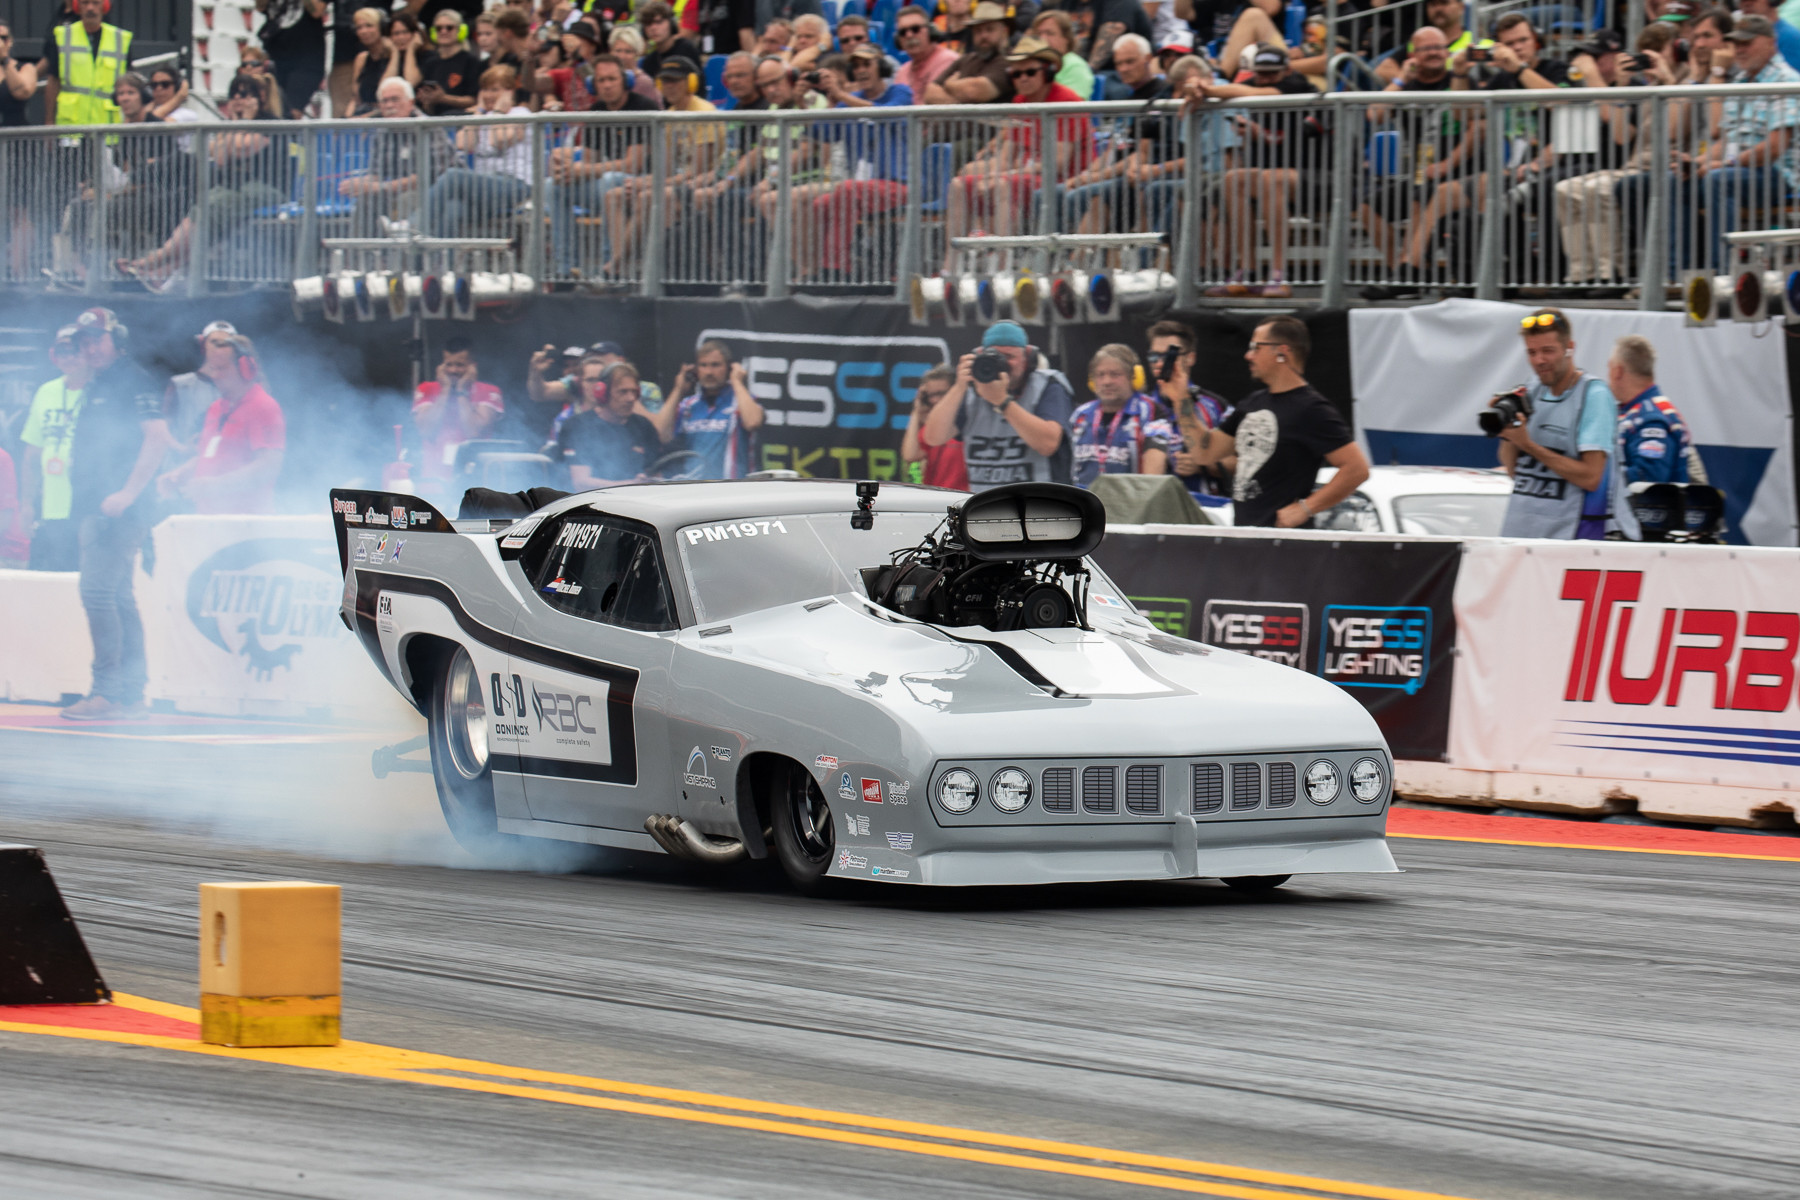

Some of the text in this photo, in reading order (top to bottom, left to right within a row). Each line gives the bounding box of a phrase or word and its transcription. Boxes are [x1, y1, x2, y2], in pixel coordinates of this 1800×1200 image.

[742, 356, 933, 430] ESSS
[1513, 476, 1558, 497] EDIA
[555, 522, 604, 550] PM1971
[684, 520, 788, 546] PM1971
[379, 595, 392, 616] FIA
[1209, 613, 1301, 647] YESSS
[1328, 616, 1425, 649] YESSS
[1559, 568, 1800, 713] TURB
[1323, 651, 1423, 678] LIGHTING
[537, 691, 597, 735] RBC
